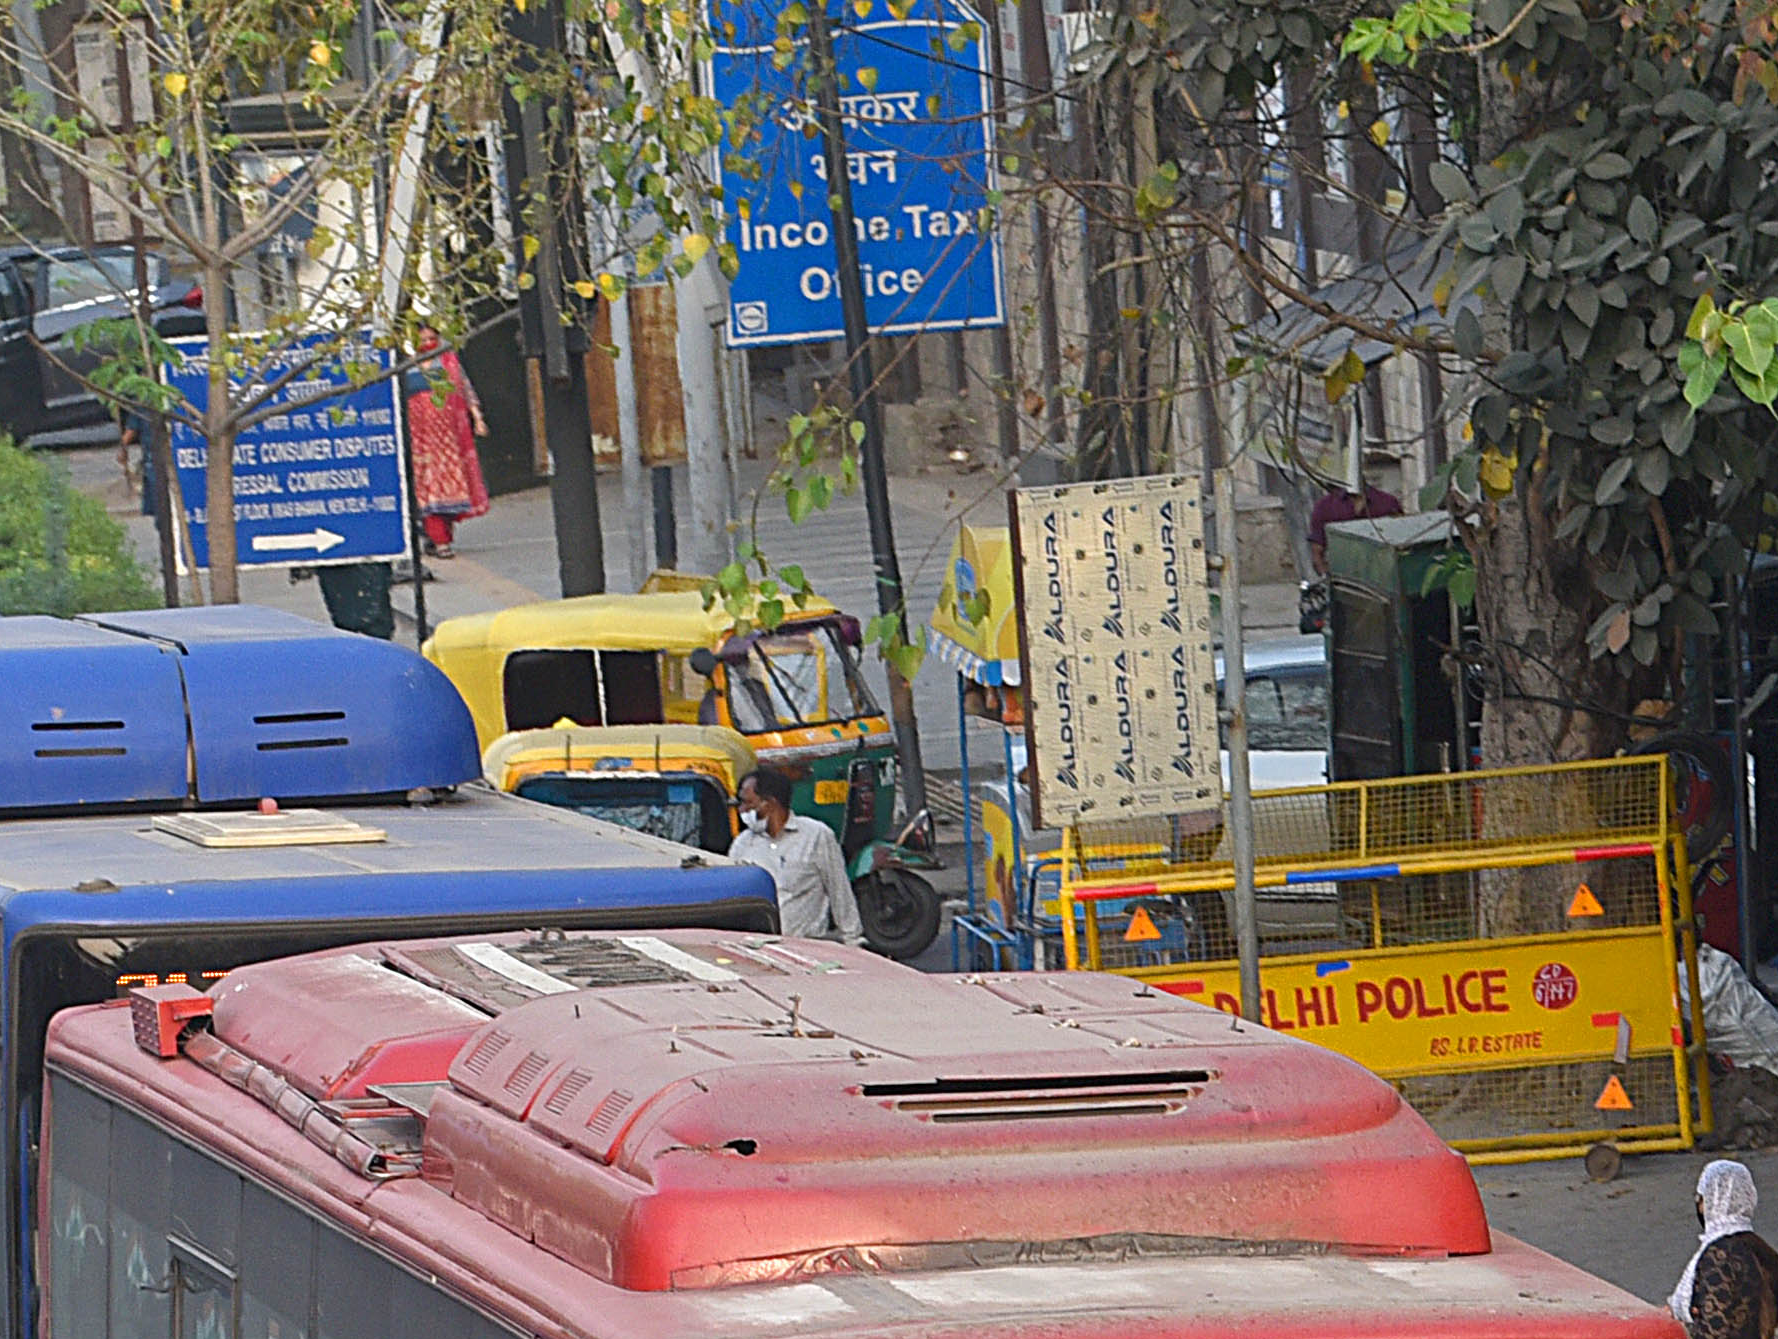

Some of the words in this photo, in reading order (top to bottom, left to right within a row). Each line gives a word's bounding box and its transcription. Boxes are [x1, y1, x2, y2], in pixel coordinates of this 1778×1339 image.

[903, 205, 974, 238] Tax
[260, 438, 332, 464] CONSUMER
[334, 434, 396, 460] DISPUTES
[287, 467, 370, 493] COMMISSION
[1214, 985, 1340, 1032] DLHI
[1356, 969, 1510, 1023] POLICE
[1483, 1031, 1542, 1054] ESTATE
